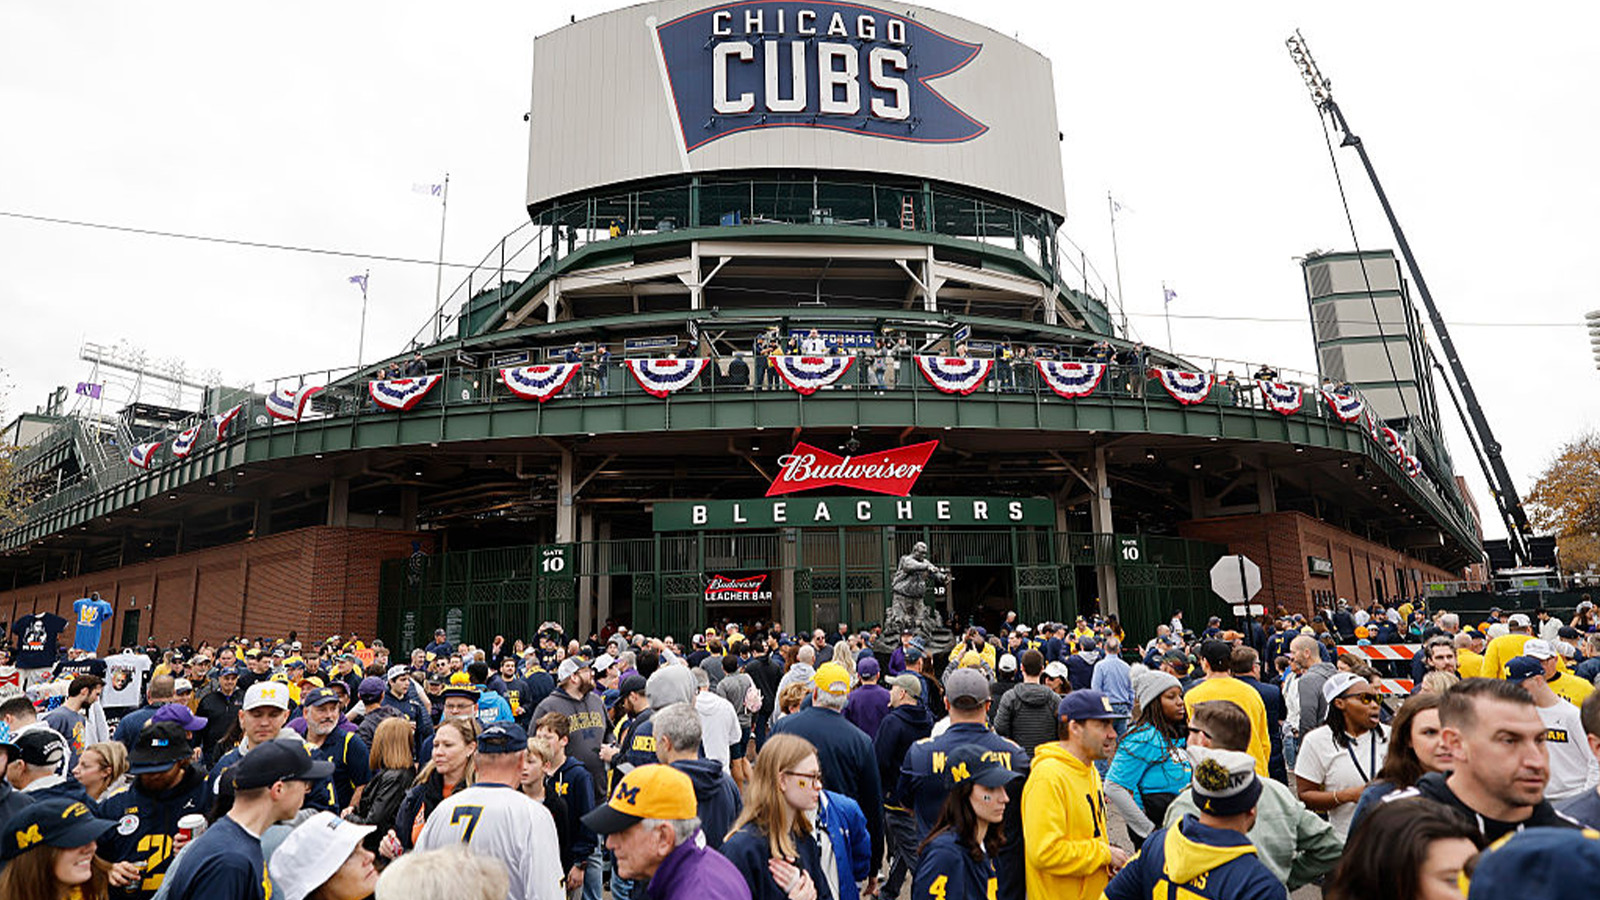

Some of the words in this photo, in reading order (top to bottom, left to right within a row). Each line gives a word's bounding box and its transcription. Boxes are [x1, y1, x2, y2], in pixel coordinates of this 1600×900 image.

[712, 9, 907, 44] CHICAGO
[713, 40, 911, 120] CUBS
[857, 334, 873, 345] 14
[777, 454, 923, 482] Budweiser
[692, 500, 1024, 525] BLEACHERS
[541, 557, 565, 573] 10
[1122, 547, 1139, 561] 10
[706, 577, 763, 591] Budweiser
[705, 592, 750, 601] LEACHER
[752, 591, 773, 601] BAR
[261, 689, 276, 699] M
[951, 762, 971, 782] M
[555, 782, 569, 797] M
[616, 782, 640, 806] M
[450, 805, 484, 844] 7
[15, 823, 44, 850] M
[928, 874, 949, 900] 4
